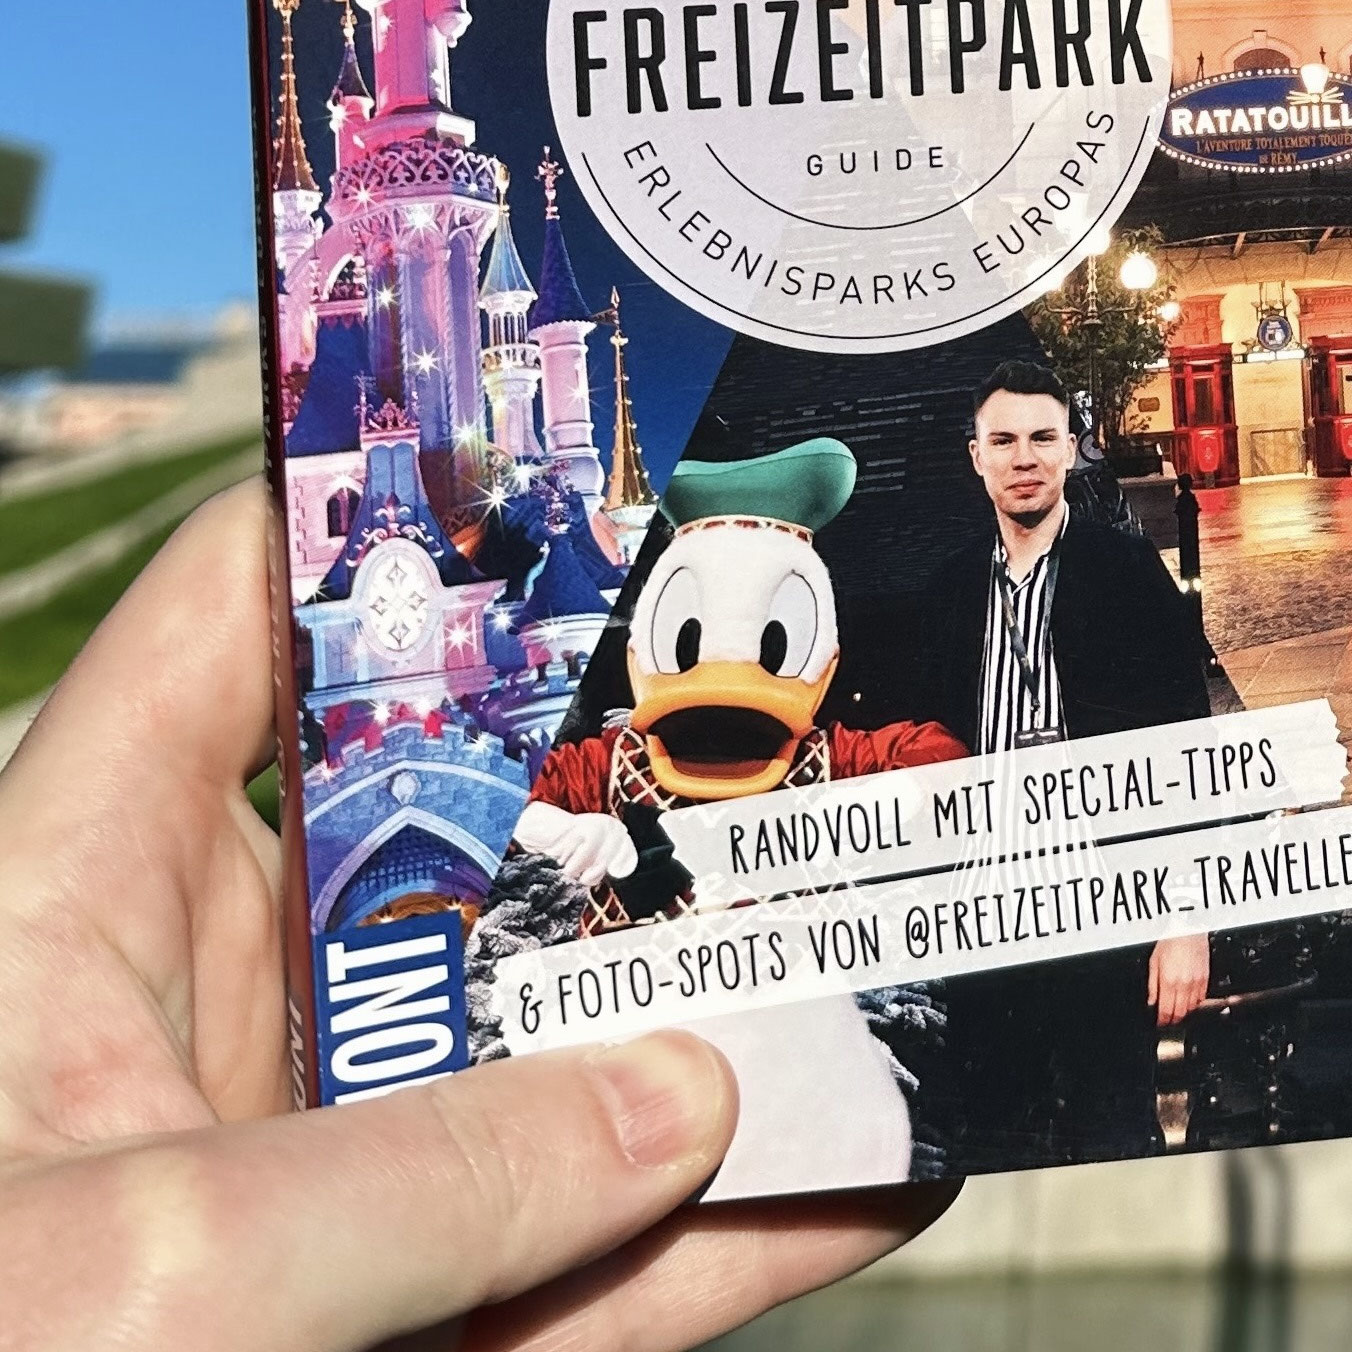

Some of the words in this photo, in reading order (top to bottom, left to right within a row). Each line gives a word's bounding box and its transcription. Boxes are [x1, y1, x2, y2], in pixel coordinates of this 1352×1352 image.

[806, 145, 944, 177] GUIDE
[1256, 134, 1317, 150] TOTALEMENT
[623, 140, 956, 305] ERLEBNISPARKS
[974, 110, 1115, 274] EUROPAS
[729, 797, 912, 874] RANDVOLL
[933, 780, 995, 838] MIT
[1023, 738, 1277, 825] SPECIAL-TIPPS
[326, 933, 455, 1105] ONT
[519, 982, 543, 1034] &
[557, 931, 787, 1025] FOTO-SPOTS
[808, 915, 881, 974] VON
